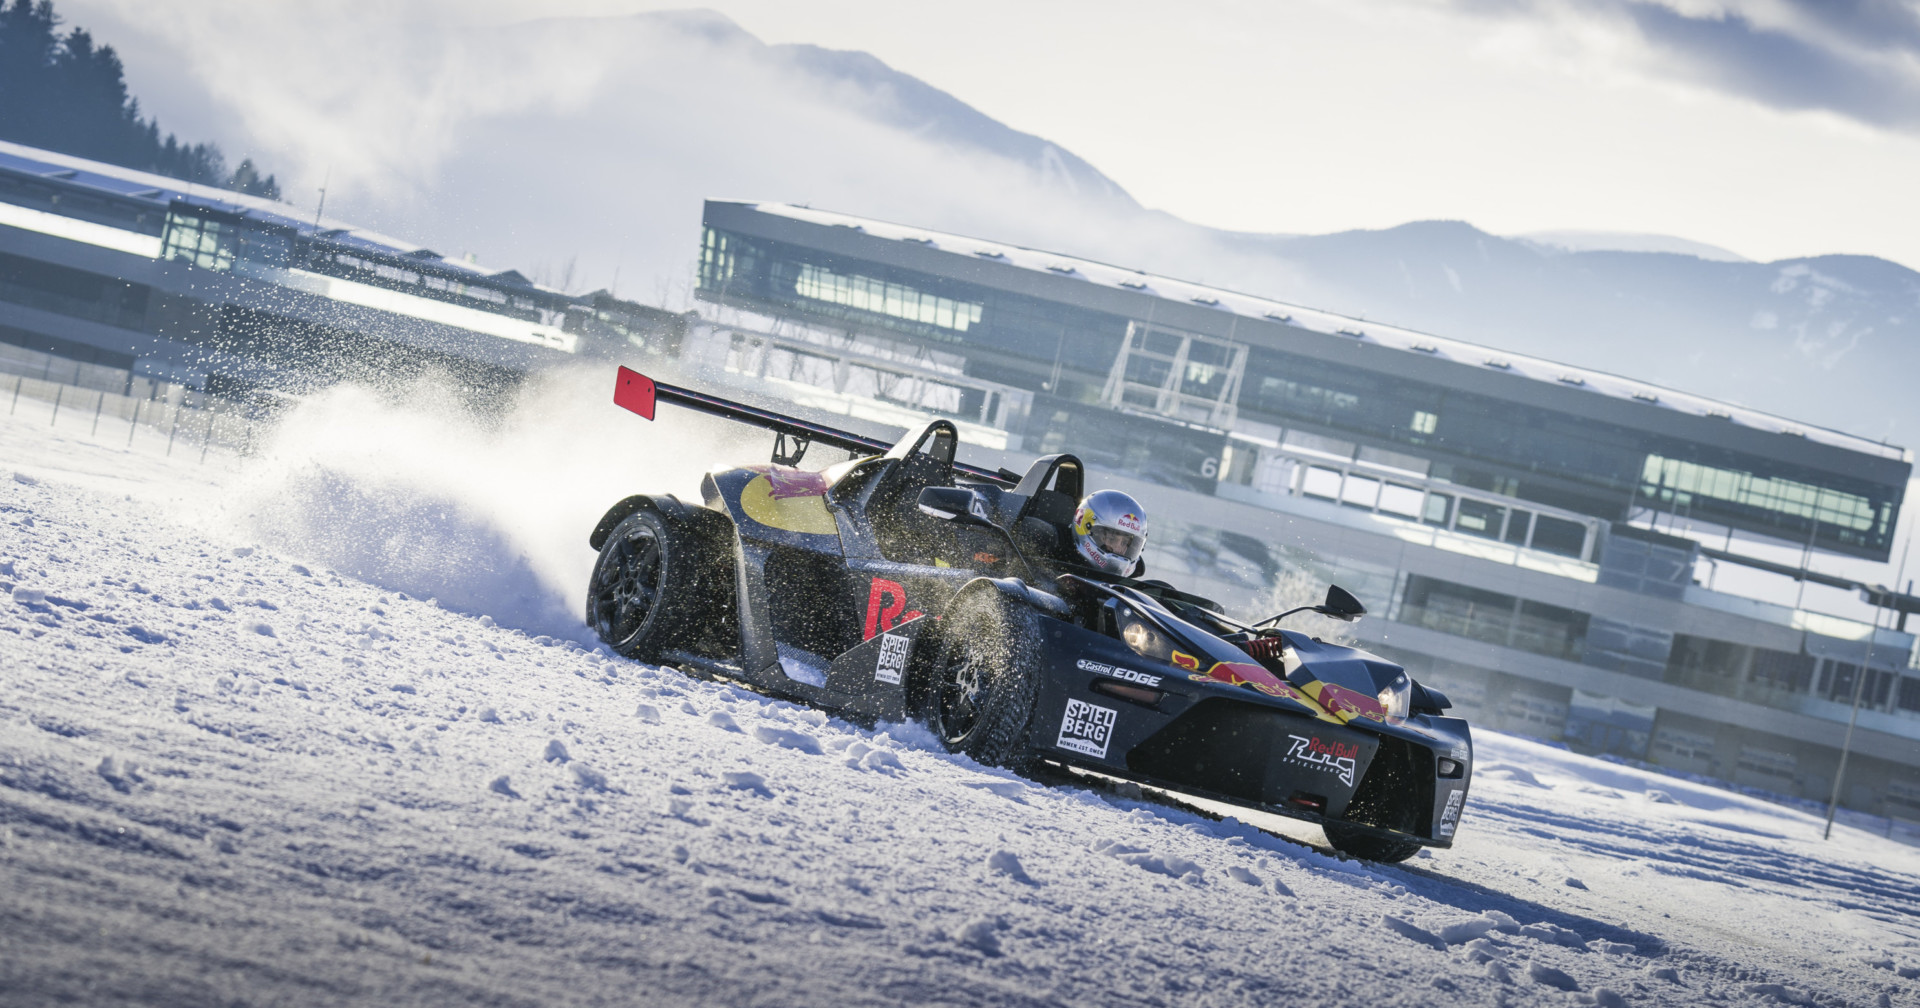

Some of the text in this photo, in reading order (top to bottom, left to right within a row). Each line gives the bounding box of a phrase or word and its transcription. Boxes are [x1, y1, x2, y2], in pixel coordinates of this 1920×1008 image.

[1201, 457, 1218, 478] 6
[1118, 519, 1140, 531] Red Bull
[1084, 542, 1108, 568] Red Bull
[1670, 560, 1685, 581] 7
[881, 637, 906, 655] SPIEL
[880, 650, 902, 669] BERG
[1085, 662, 1163, 687] Castrol EDGE
[1068, 703, 1112, 727] SPIEL
[1062, 717, 1106, 742] BERG
[1309, 737, 1359, 759] Red Bull
